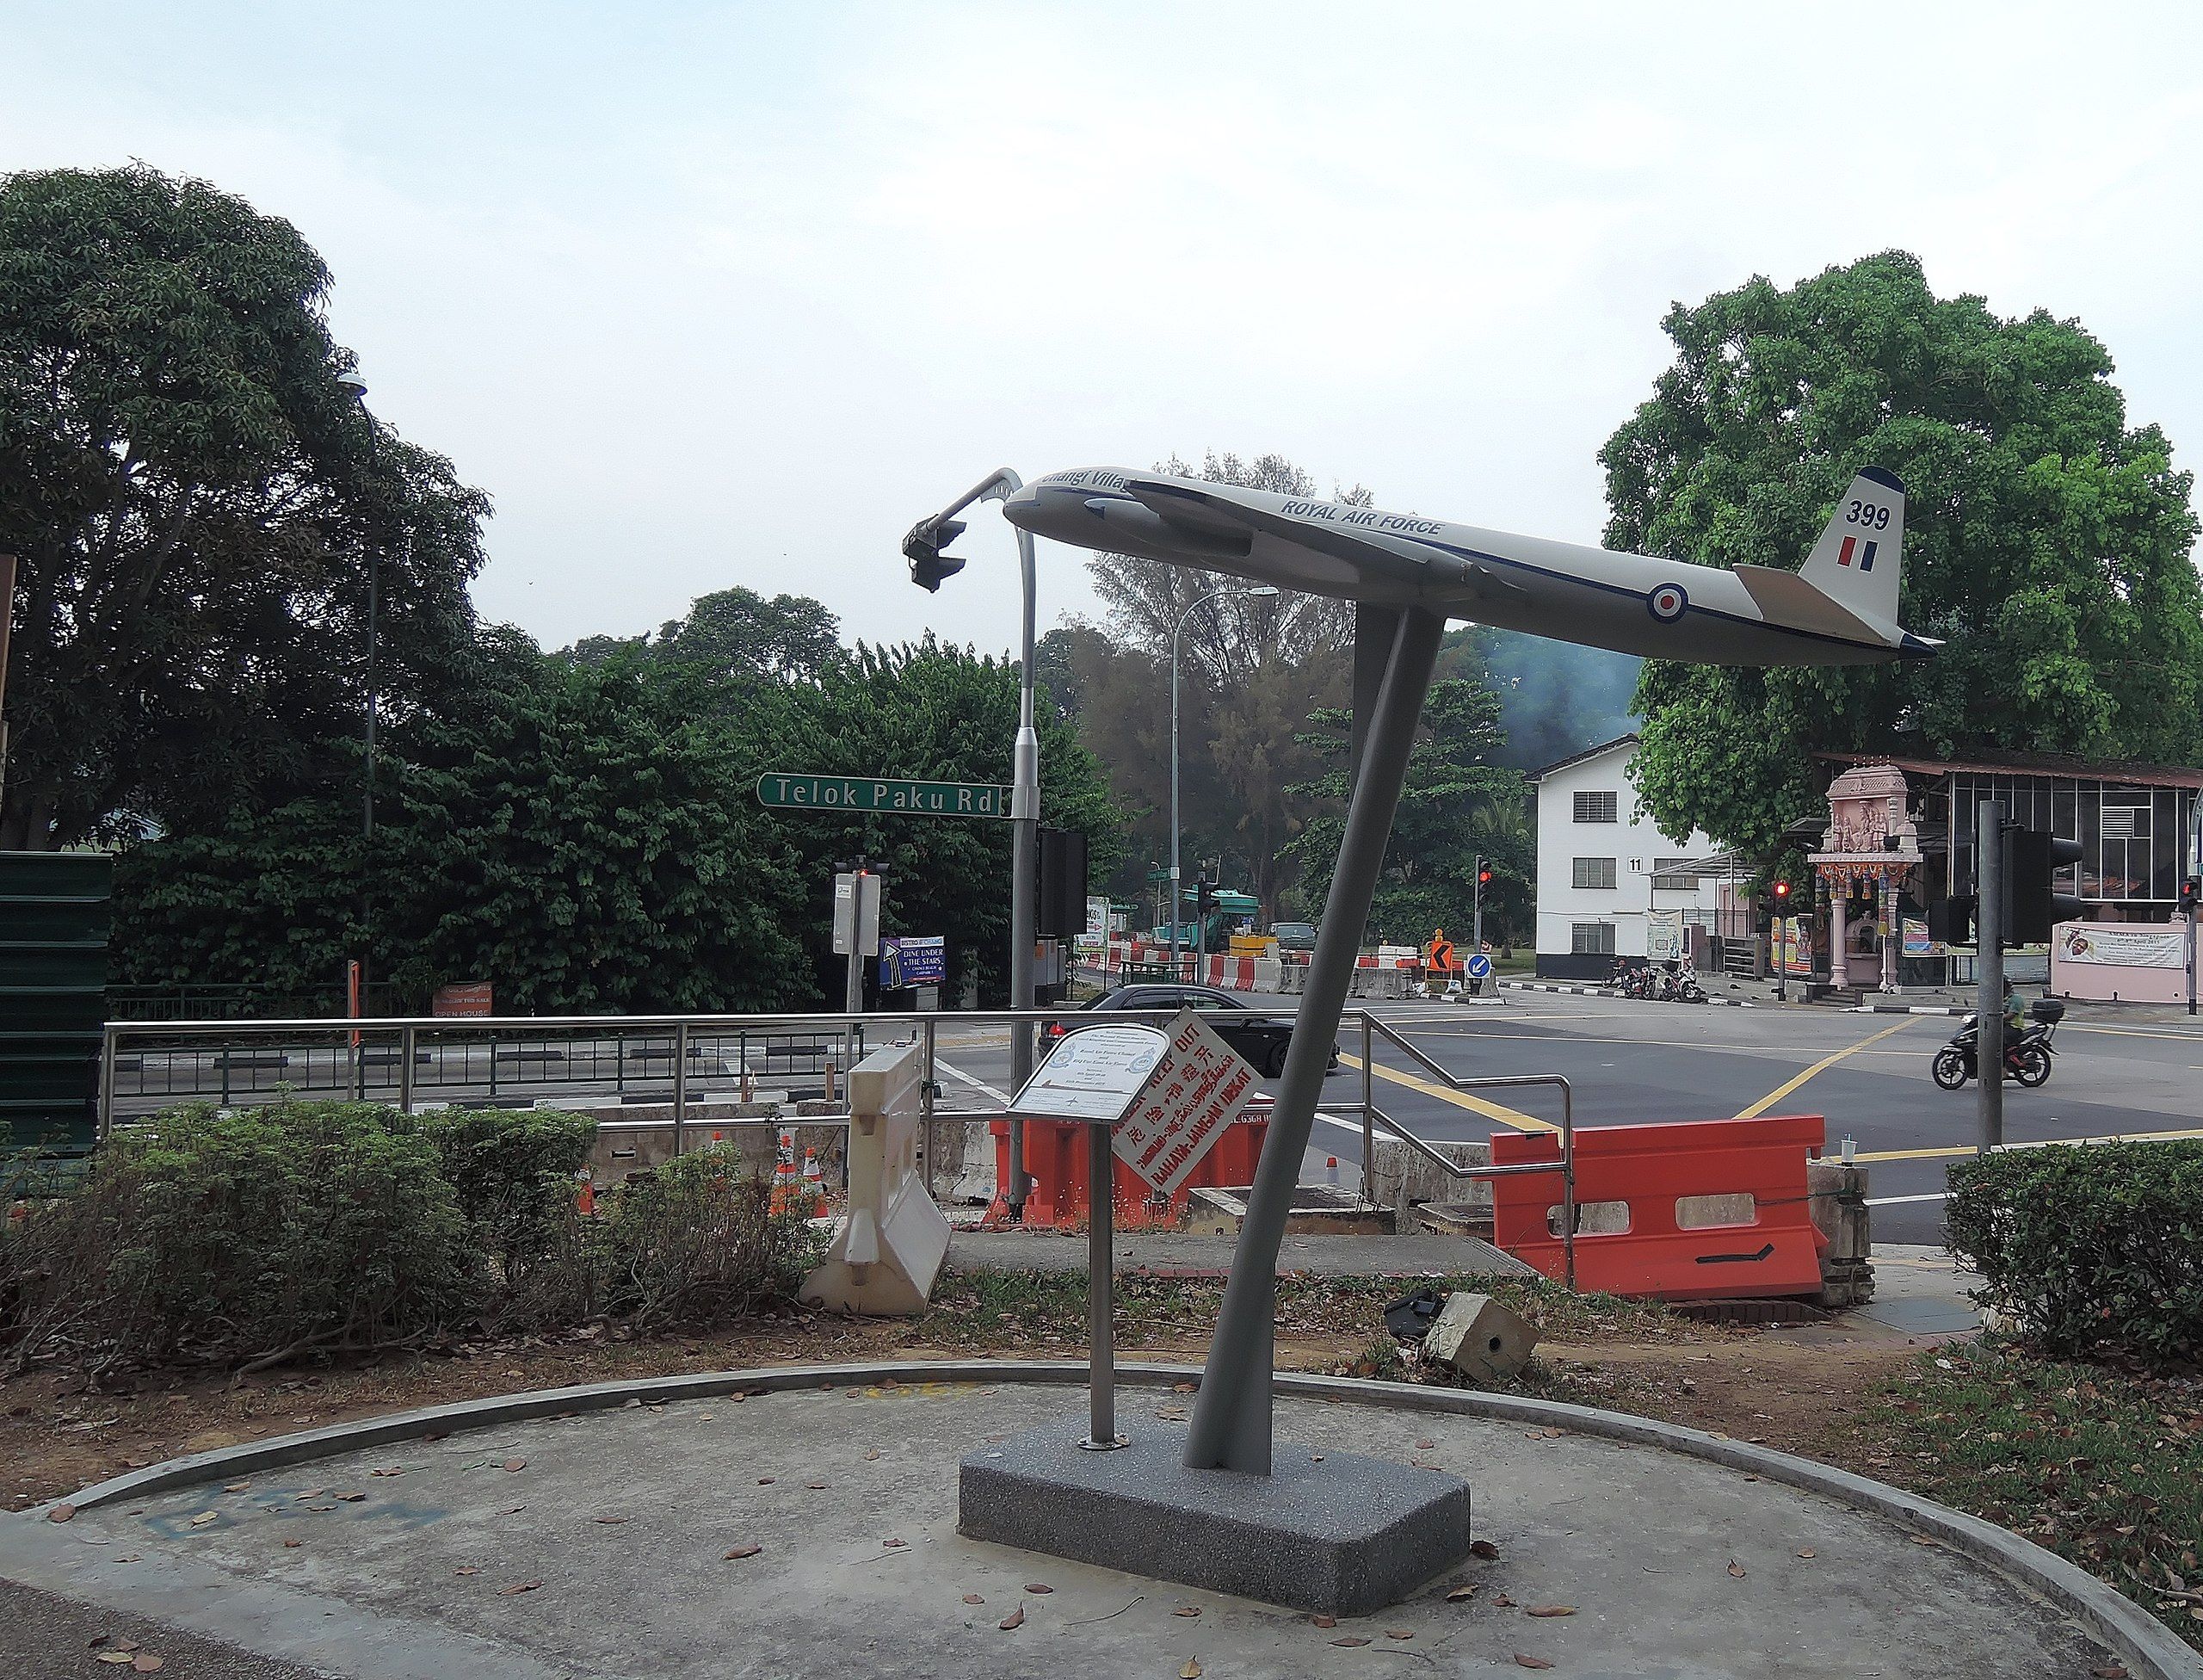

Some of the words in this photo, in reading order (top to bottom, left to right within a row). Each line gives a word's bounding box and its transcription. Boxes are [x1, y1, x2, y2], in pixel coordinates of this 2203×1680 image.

[1280, 500, 1336, 521] ROYAL
[1341, 510, 1378, 526] AIR
[1379, 516, 1446, 535] FORCE
[1845, 498, 1891, 532] 399
[775, 778, 857, 806] Telok
[873, 784, 943, 810] Paku
[957, 788, 992, 812] Rd
[1629, 858, 1641, 871] 11
[904, 949, 919, 958] DINE
[921, 948, 943, 957] UNDER
[1174, 1022, 1200, 1053] OUT
